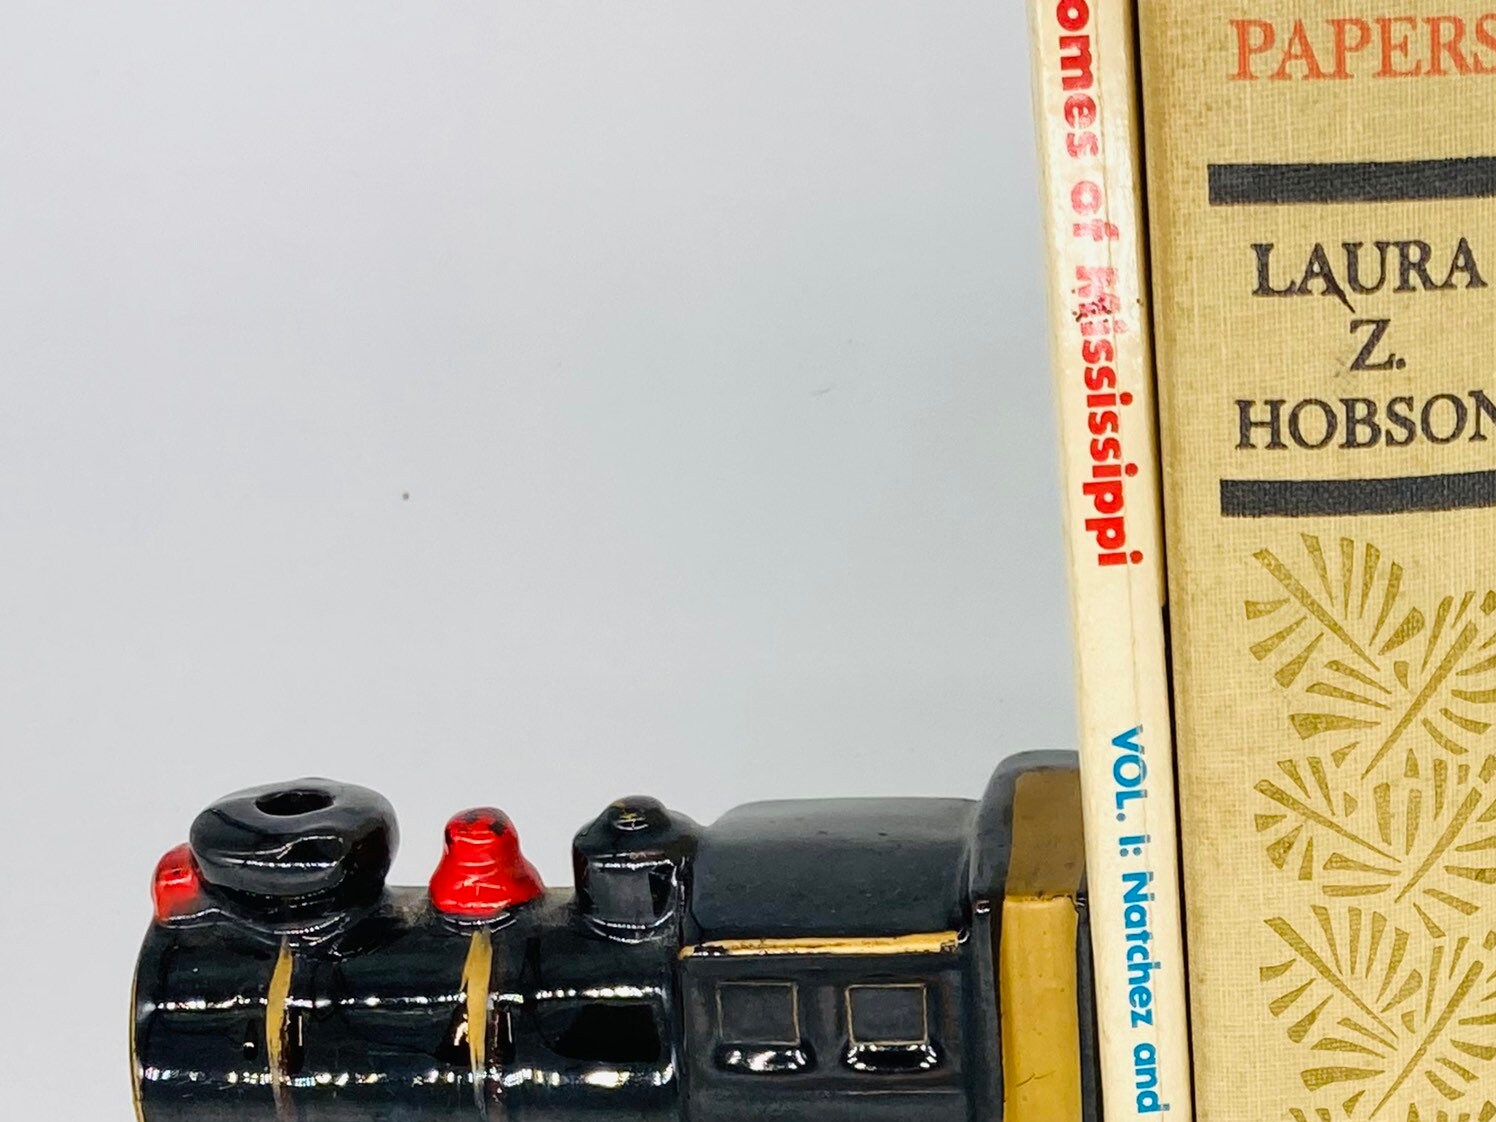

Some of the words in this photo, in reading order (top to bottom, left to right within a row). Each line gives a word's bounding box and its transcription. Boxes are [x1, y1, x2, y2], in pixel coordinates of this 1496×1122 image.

[1071, 180, 1119, 242] of
[1250, 236, 1488, 300] LAURA
[1349, 318, 1406, 373] Z.
[1076, 265, 1143, 566] Mississippi
[1111, 725, 1147, 822] VOL.
[1121, 871, 1161, 1029] Natchez
[1133, 1041, 1170, 1114] and
